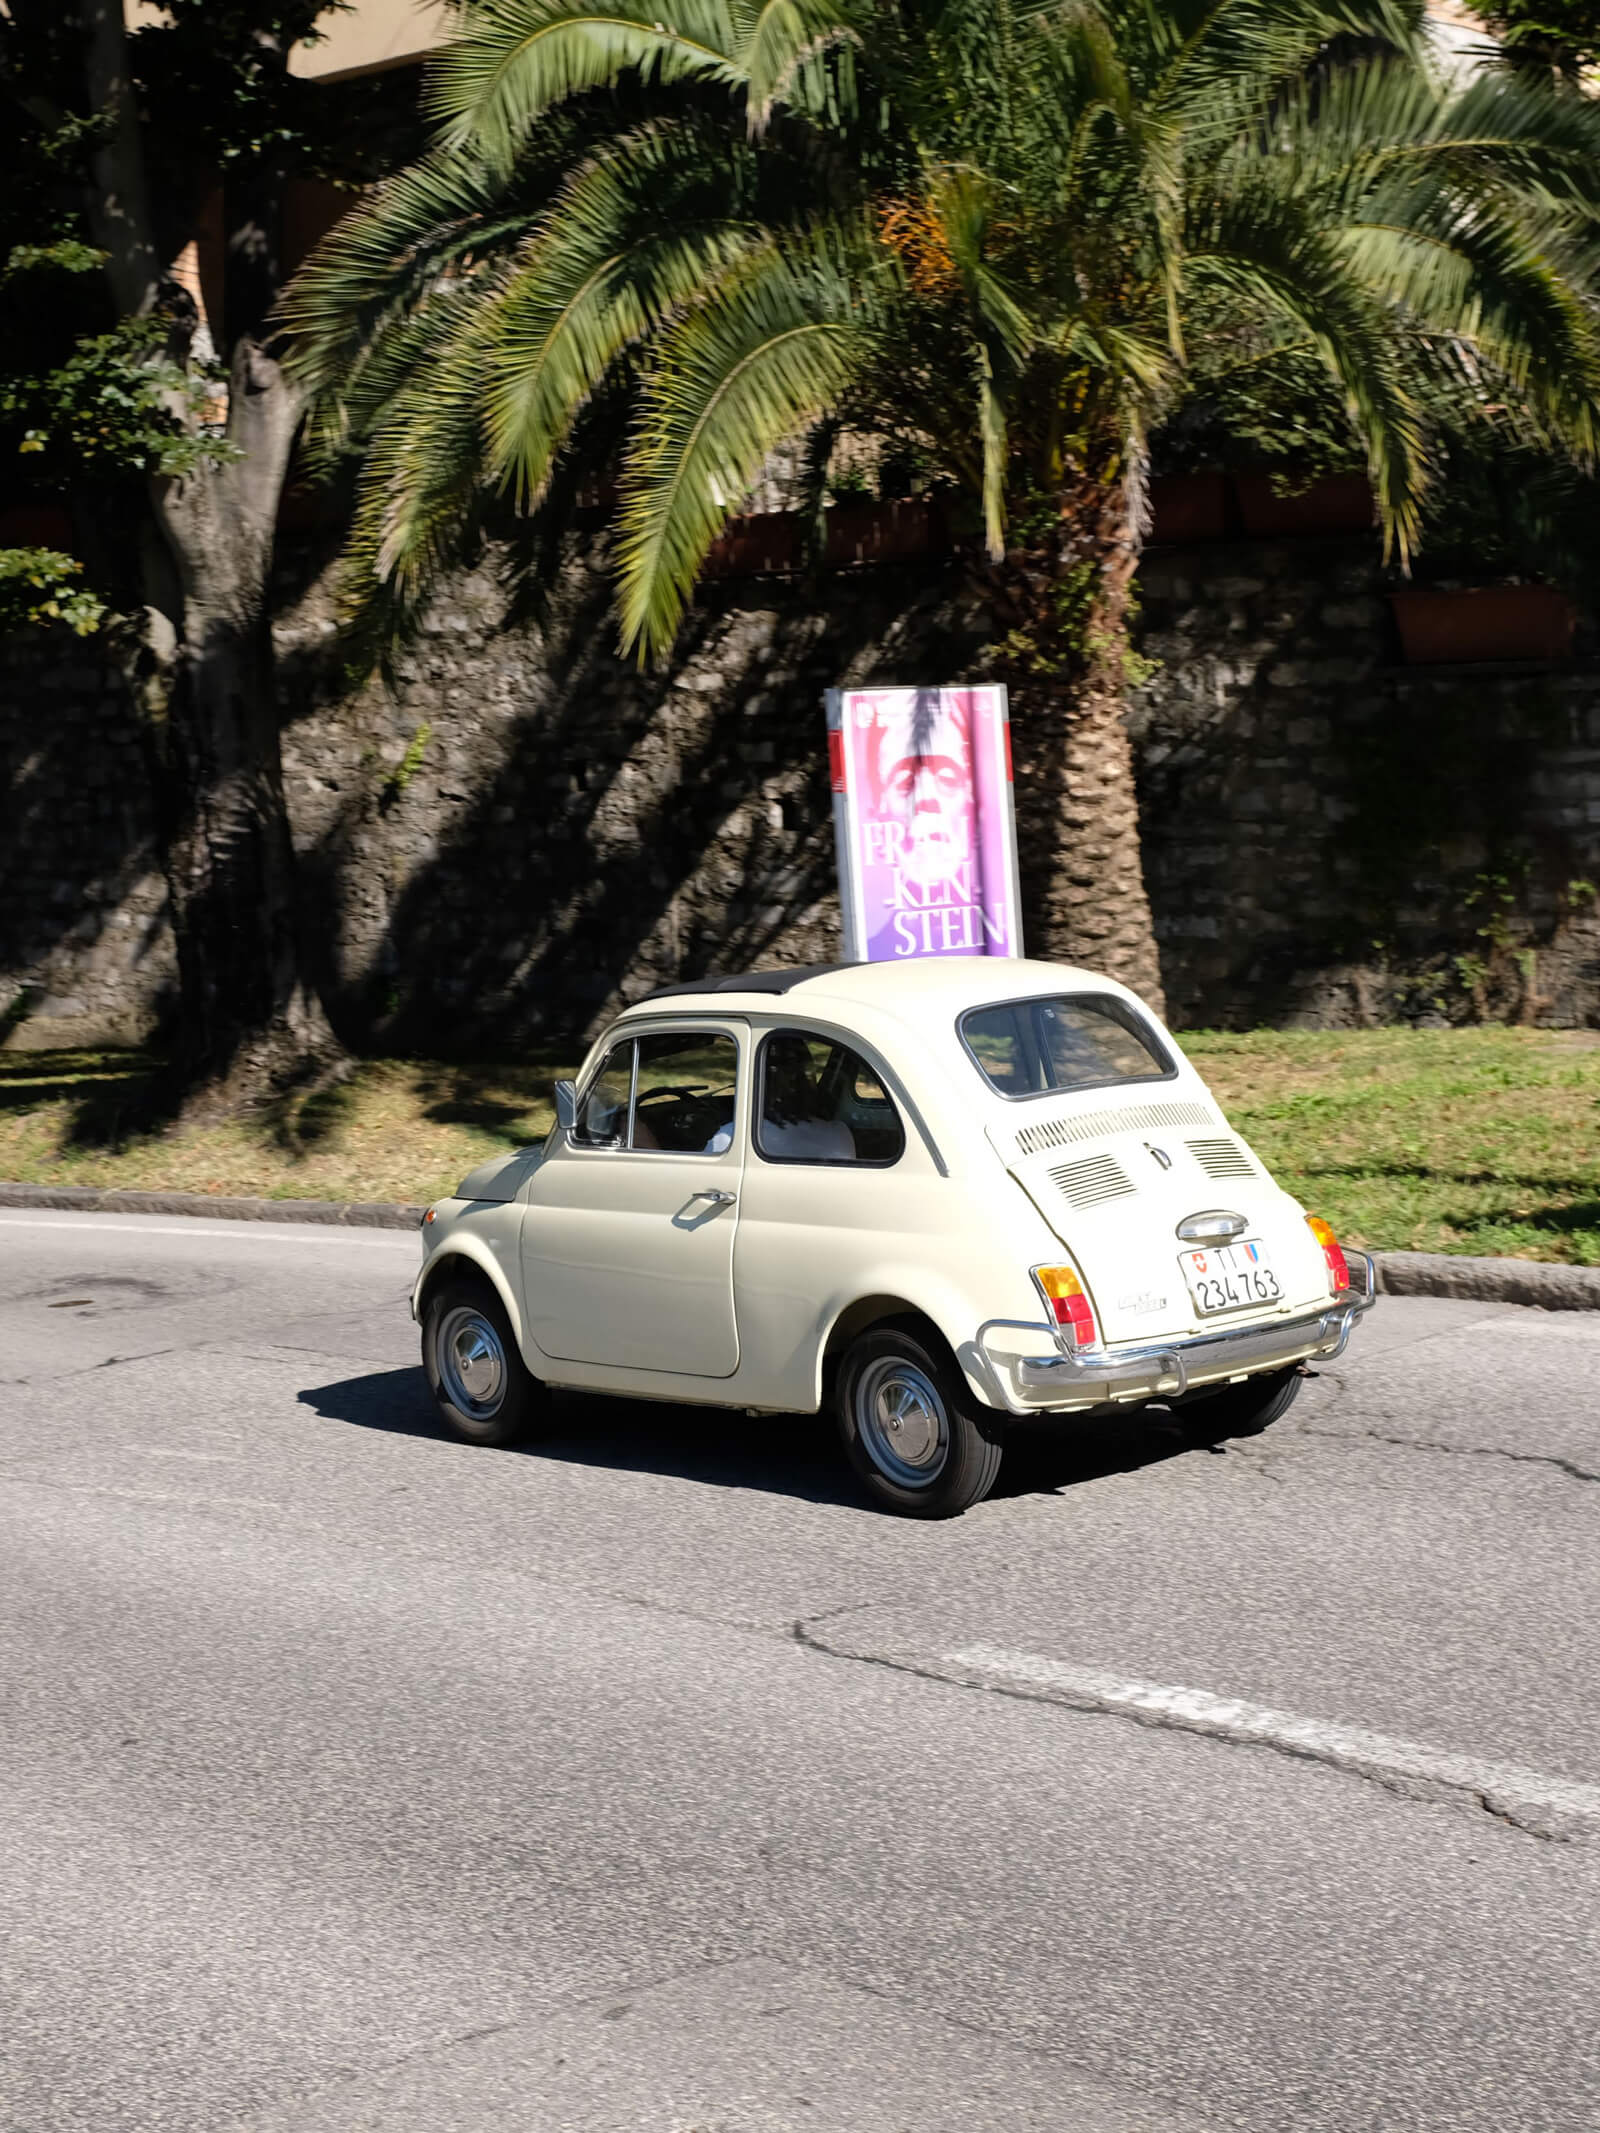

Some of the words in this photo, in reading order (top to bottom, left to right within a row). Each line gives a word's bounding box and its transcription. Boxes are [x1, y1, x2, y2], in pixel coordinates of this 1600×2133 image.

[893, 903, 1006, 955] STEIN
[1214, 1248, 1237, 1271] TI
[1197, 1269, 1280, 1310] 234763
